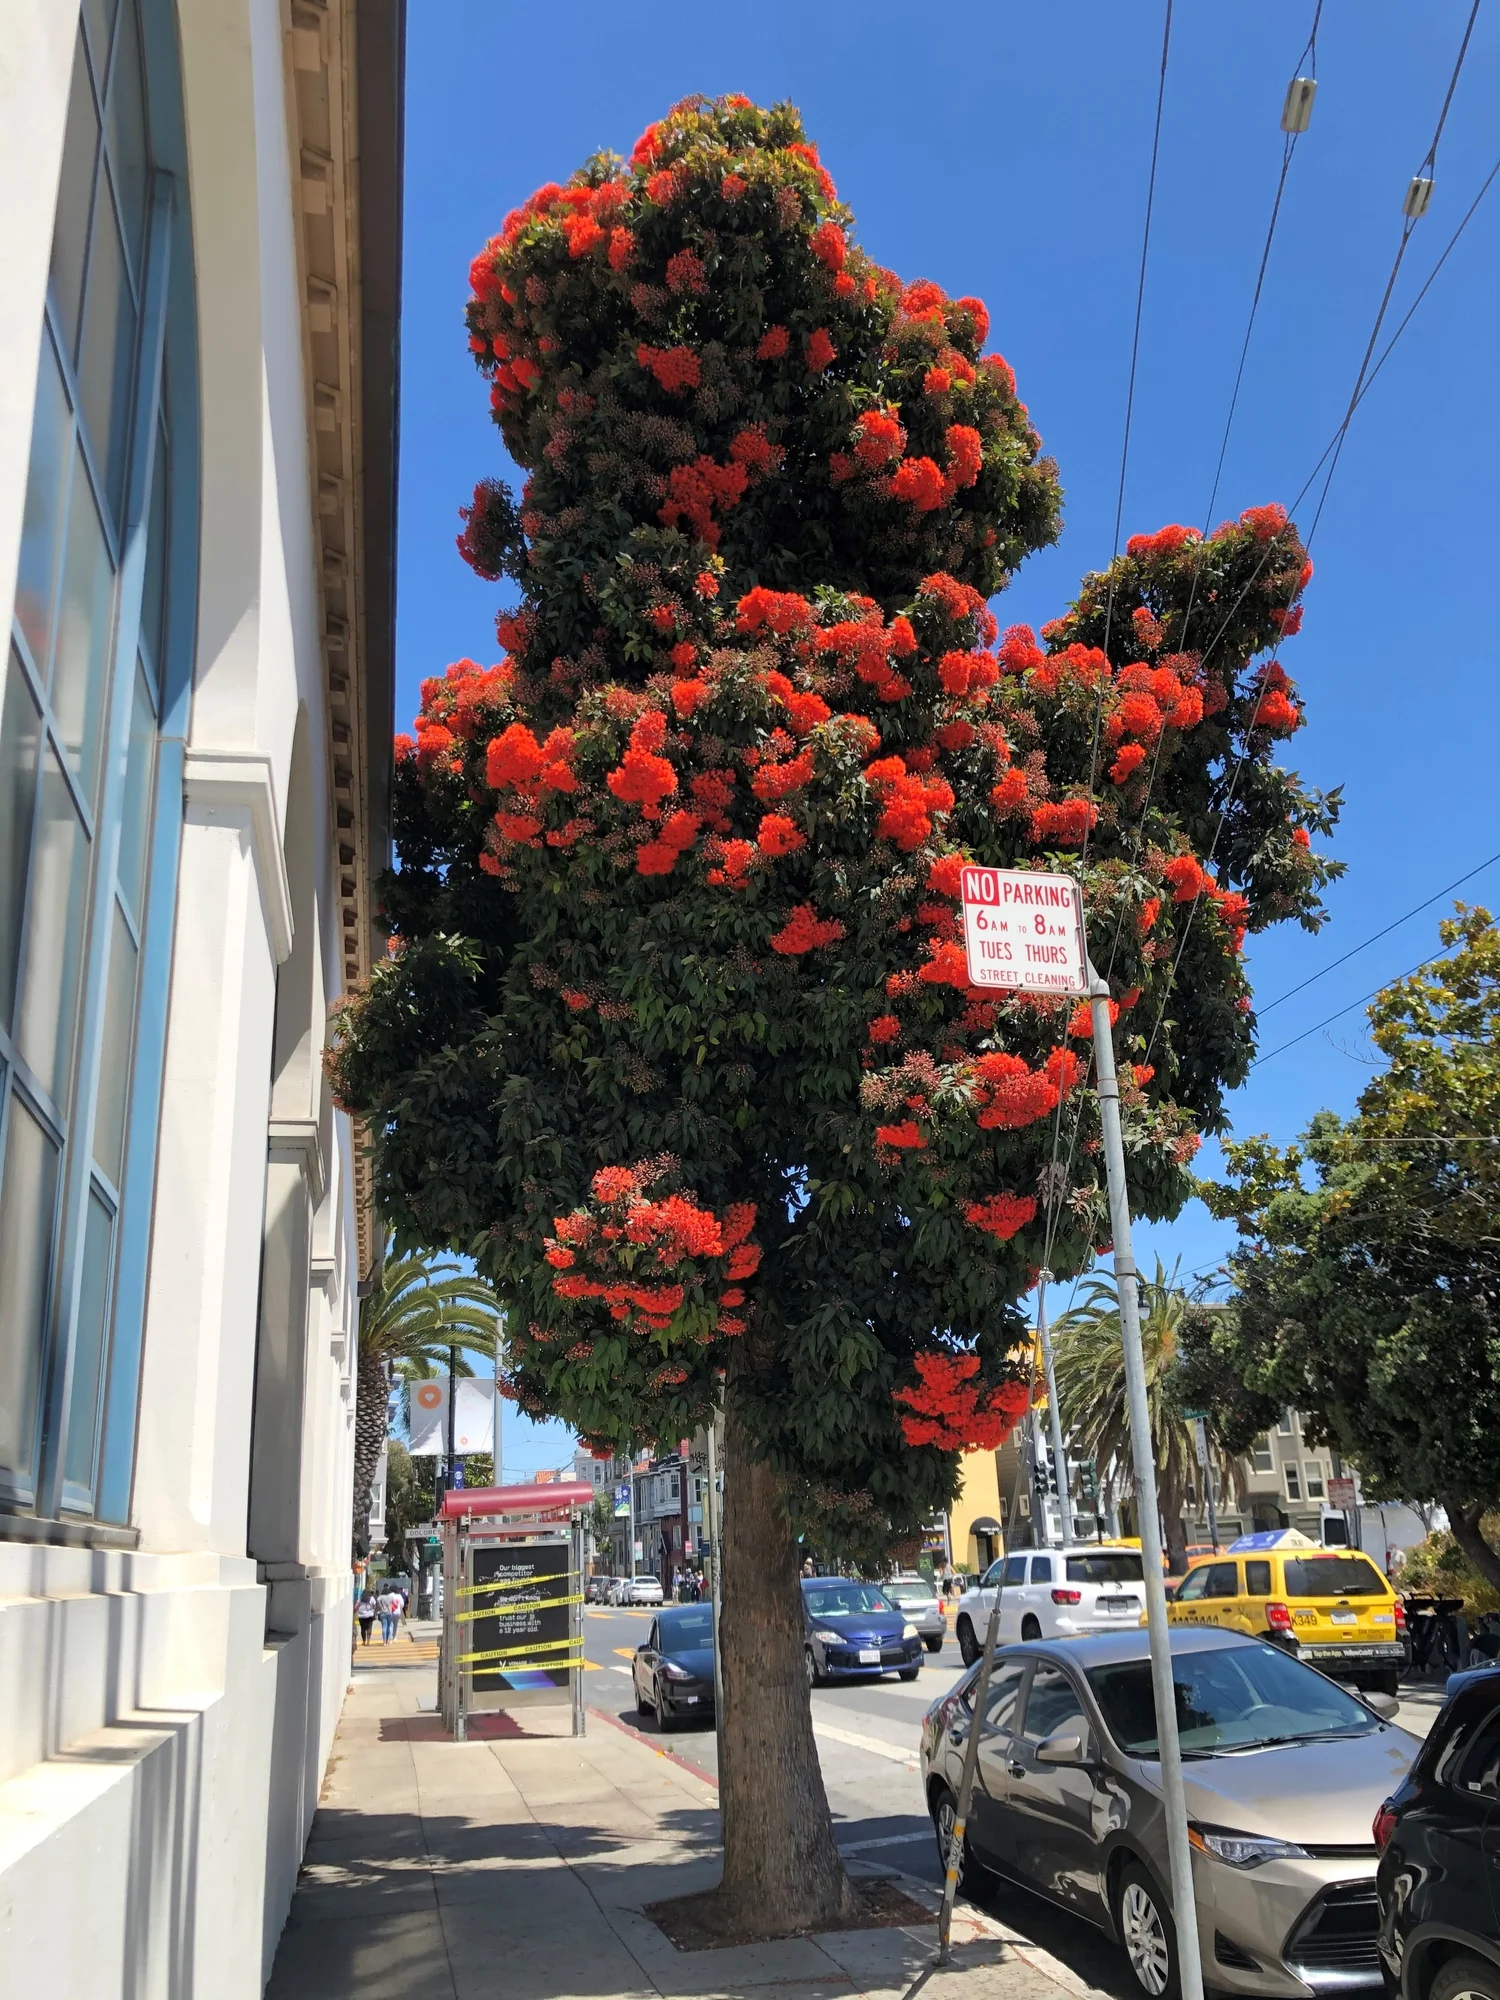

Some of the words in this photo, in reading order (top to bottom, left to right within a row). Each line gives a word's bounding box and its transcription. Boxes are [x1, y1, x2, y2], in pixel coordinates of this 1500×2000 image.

[966, 871, 995, 902] NO
[1003, 882, 1070, 908] PARKING
[1018, 925, 1027, 934] TO
[979, 940, 1013, 960] TUES
[1025, 944, 1068, 964] THURS
[980, 968, 1019, 983] STREET
[1025, 972, 1075, 987] CLEANING
[1290, 1539, 1304, 1547] TAXI
[511, 1563, 535, 1571] biggest
[460, 1585, 488, 1595] CAUTION
[468, 1609, 496, 1619] CAUTION
[513, 1602, 541, 1611] CAUTION
[526, 1619, 542, 1627] with
[1291, 1615, 1318, 1626] K349
[480, 1650, 508, 1659] CAUTION
[524, 1643, 552, 1653] CAUTION
